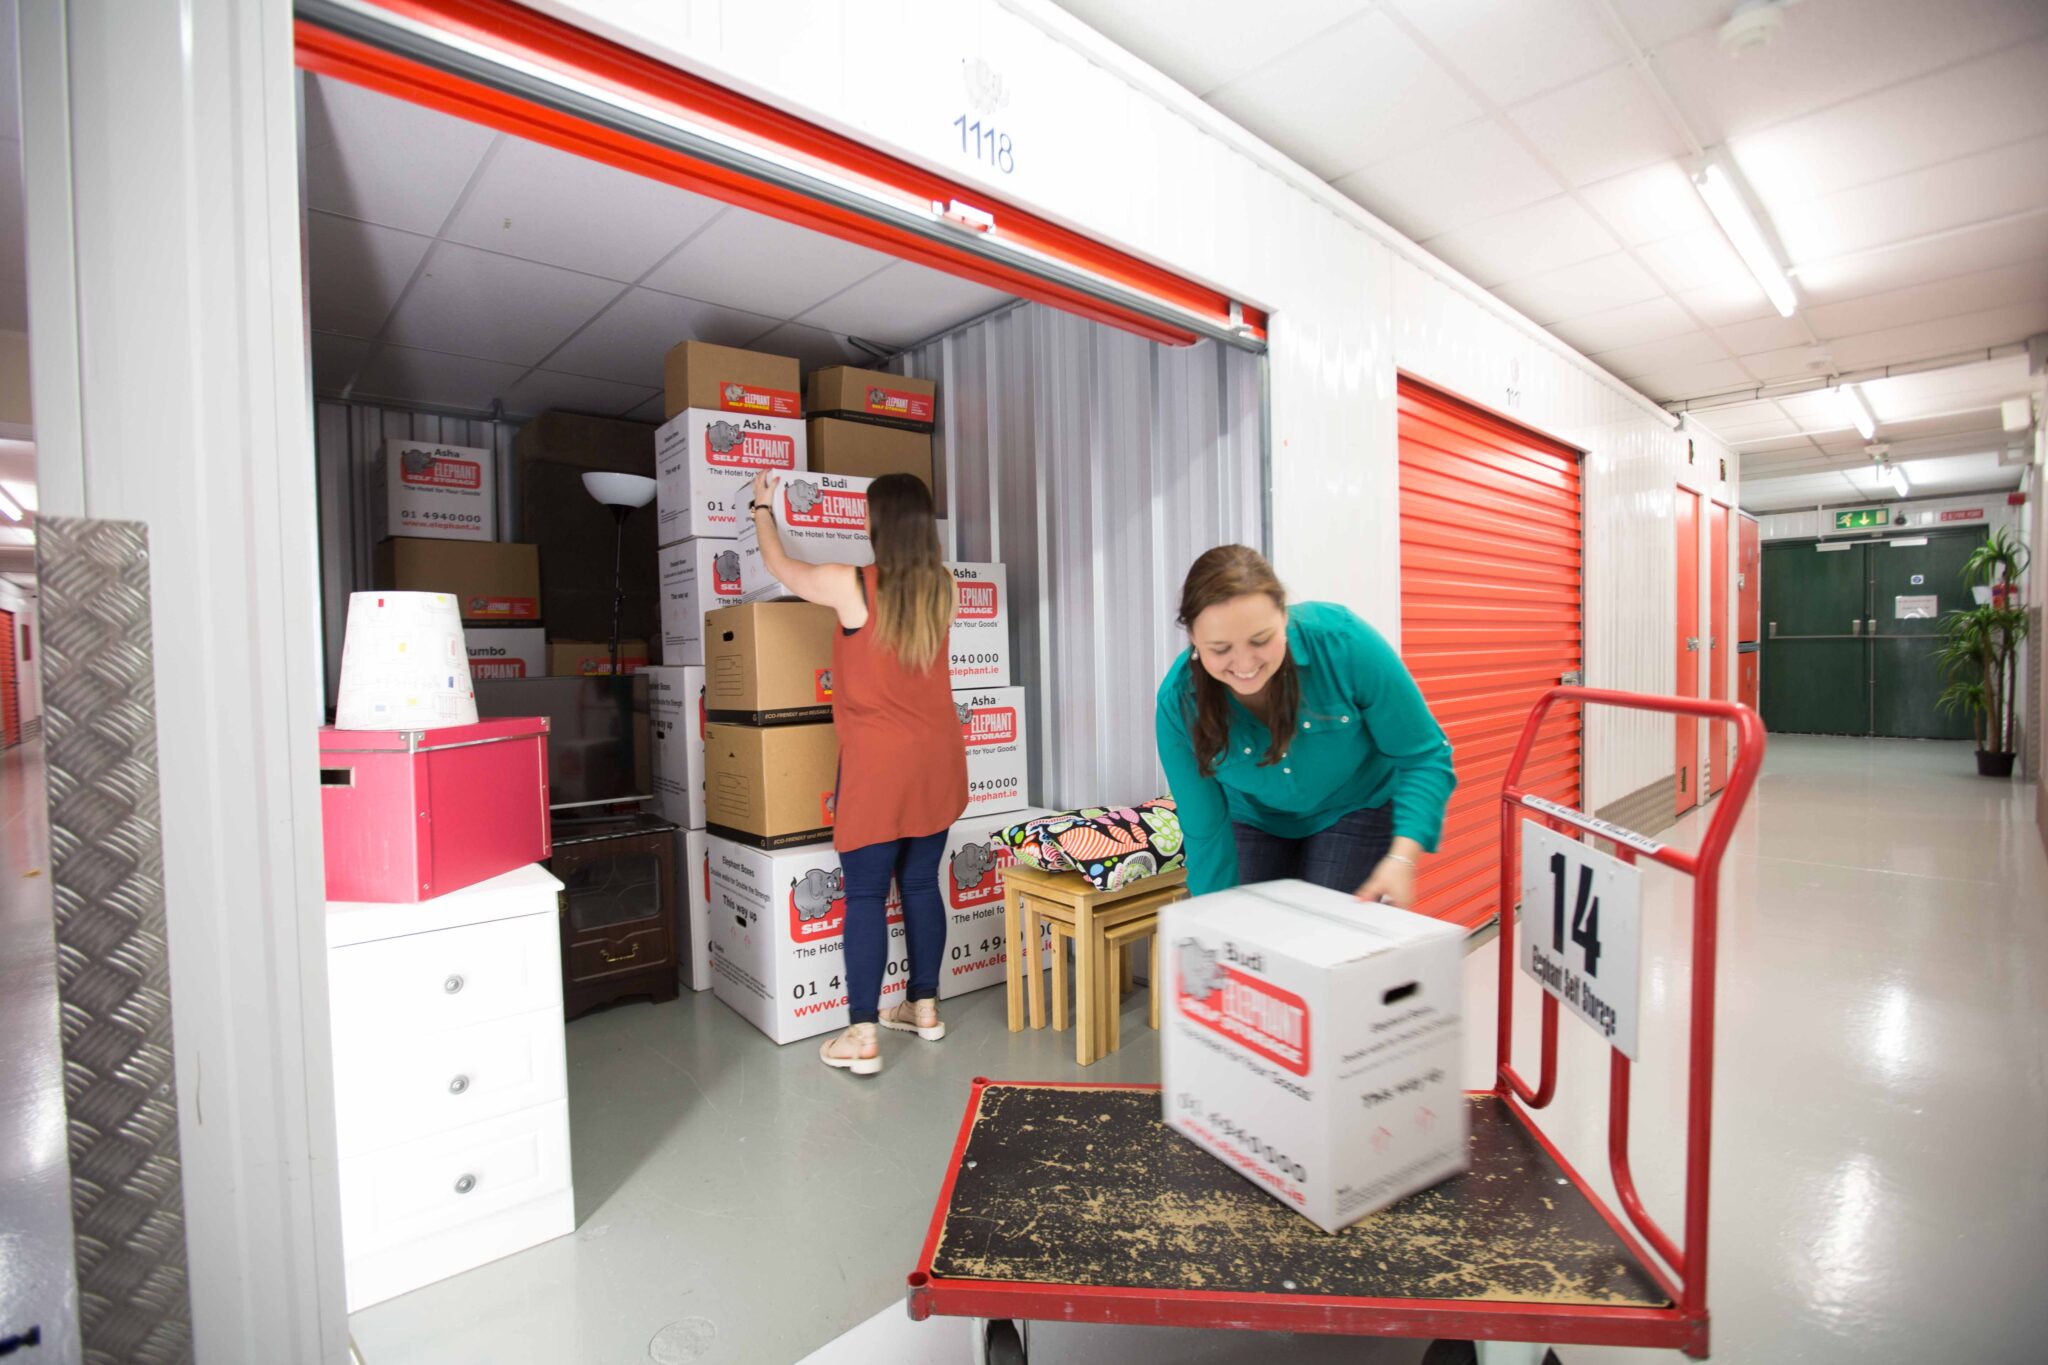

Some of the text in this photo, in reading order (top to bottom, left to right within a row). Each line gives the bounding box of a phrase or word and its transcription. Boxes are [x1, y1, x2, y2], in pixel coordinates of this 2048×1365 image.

[954, 114, 1014, 174] 1118
[743, 419, 771, 431] Asha
[434, 448, 460, 458] Asha
[743, 437, 790, 459] ELEPHANT
[712, 454, 789, 466] SELF STORAGE
[434, 462, 478, 480] ELEPHANT
[724, 468, 743, 477] Hotel
[745, 470, 754, 478] for
[822, 476, 847, 489] Budi
[707, 501, 724, 512] 01
[401, 510, 481, 523] 01 4940000
[793, 514, 865, 525] SELF STORAG
[805, 530, 824, 538] Hotel
[825, 531, 836, 540] for
[837, 532, 852, 540] Your
[953, 568, 977, 579] Asha
[720, 583, 742, 591] SEL
[951, 653, 999, 664] 940000
[971, 695, 996, 706] Asha
[971, 712, 1012, 734] ELEPHANT
[970, 732, 1012, 741] STORAGE
[970, 777, 1018, 792] 940000
[959, 887, 990, 902] SELF
[723, 894, 758, 924] This way up
[973, 907, 995, 921] Hotel
[1550, 852, 1601, 978] 14
[801, 918, 843, 935] SELF
[819, 942, 844, 954] Hote
[951, 943, 971, 961] 01
[793, 981, 818, 1000] 01
